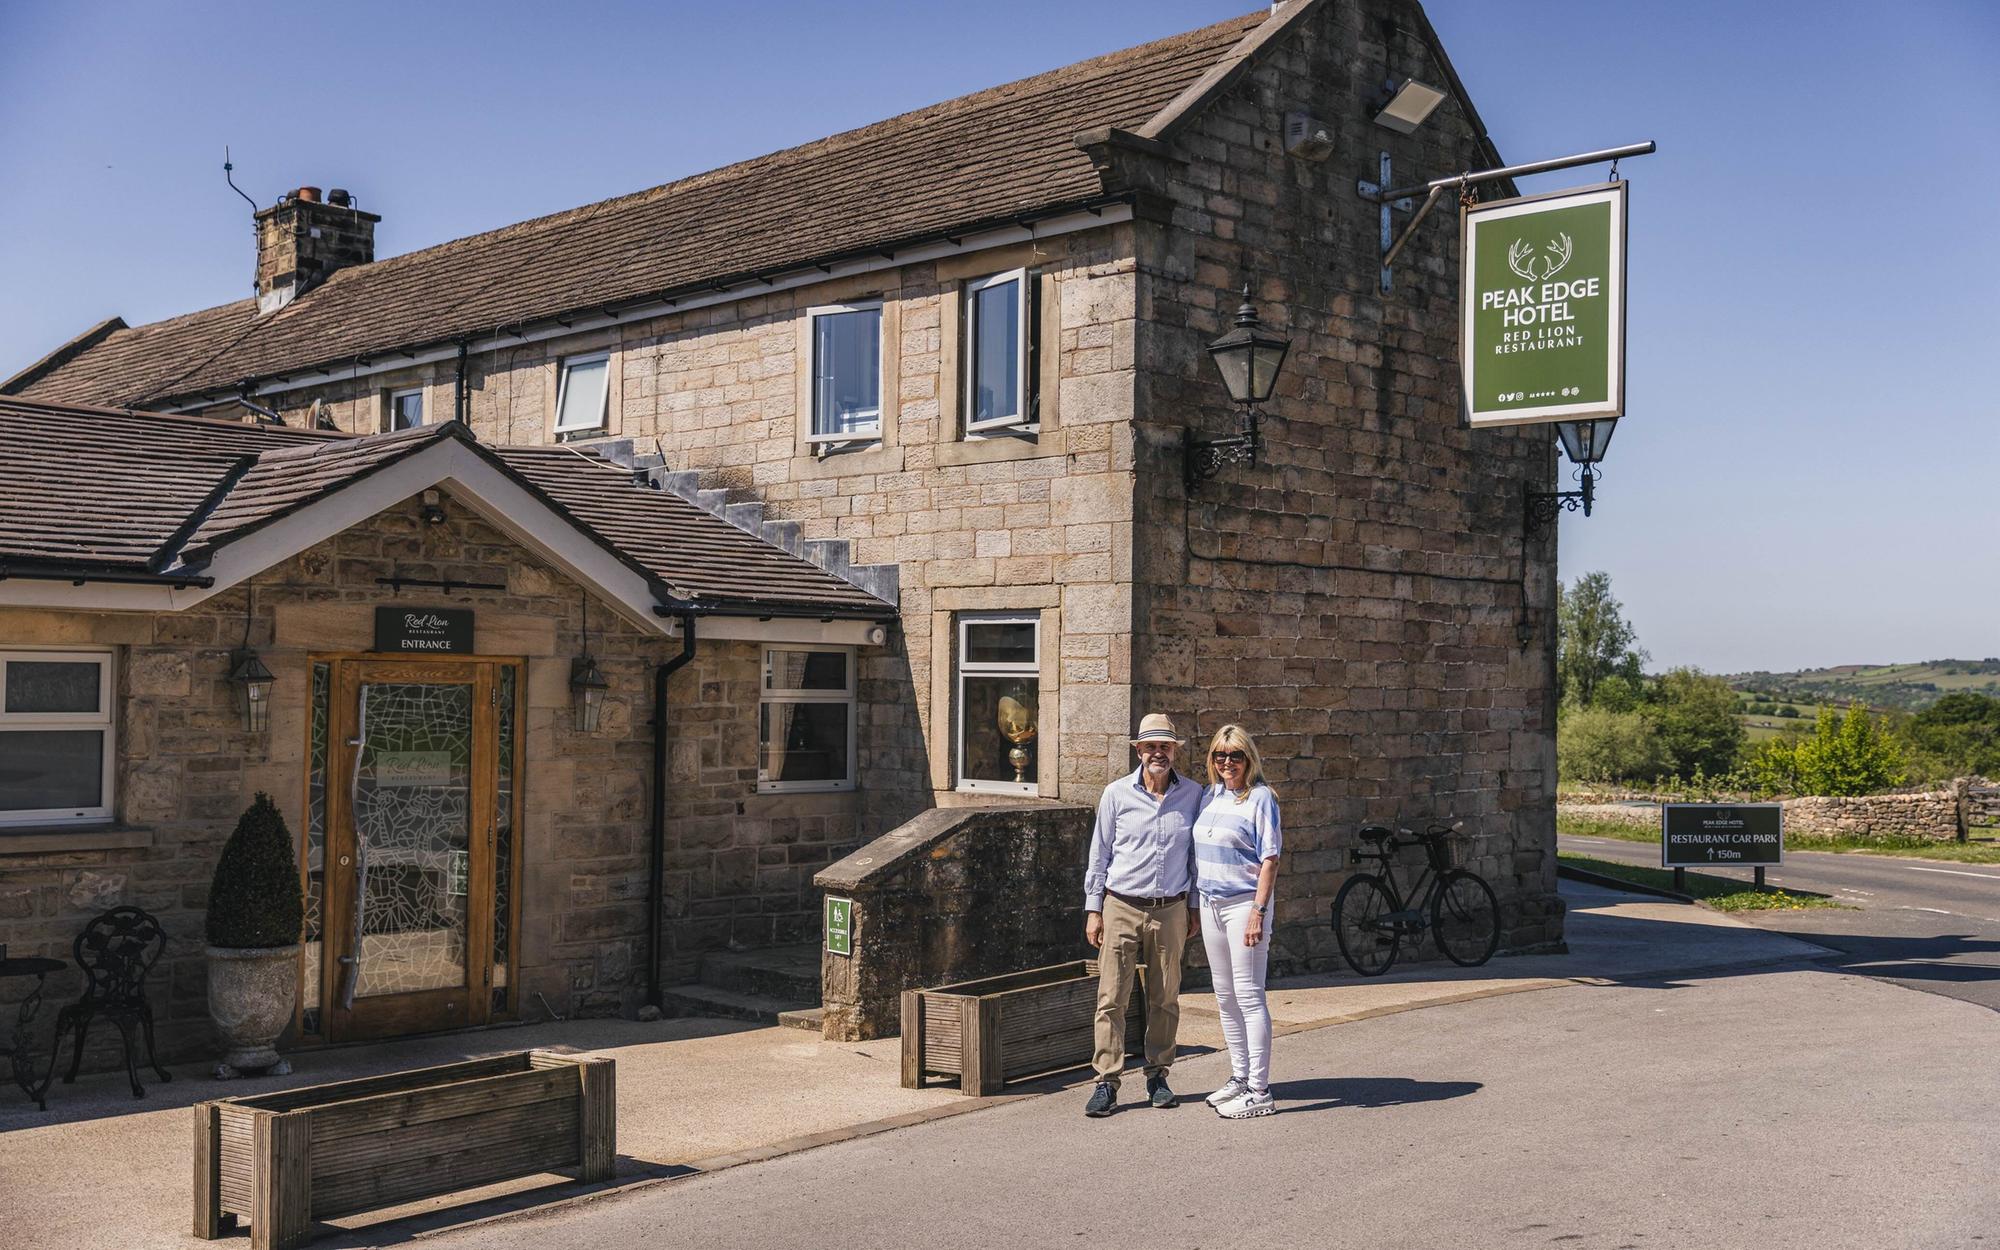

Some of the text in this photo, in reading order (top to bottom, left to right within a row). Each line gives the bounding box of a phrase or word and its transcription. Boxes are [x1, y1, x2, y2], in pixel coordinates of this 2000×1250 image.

[1482, 278, 1600, 310] PEAK EDGE
[1503, 302, 1575, 327] HOTEL
[1503, 325, 1575, 342] RED LION
[1495, 336, 1584, 354] RESTAURANT
[404, 613, 449, 630] Red Lion
[401, 640, 452, 649] ENTRANCE
[1671, 834, 1777, 844] RESTAURANT CAR PARK
[1717, 850, 1741, 859] 150m
